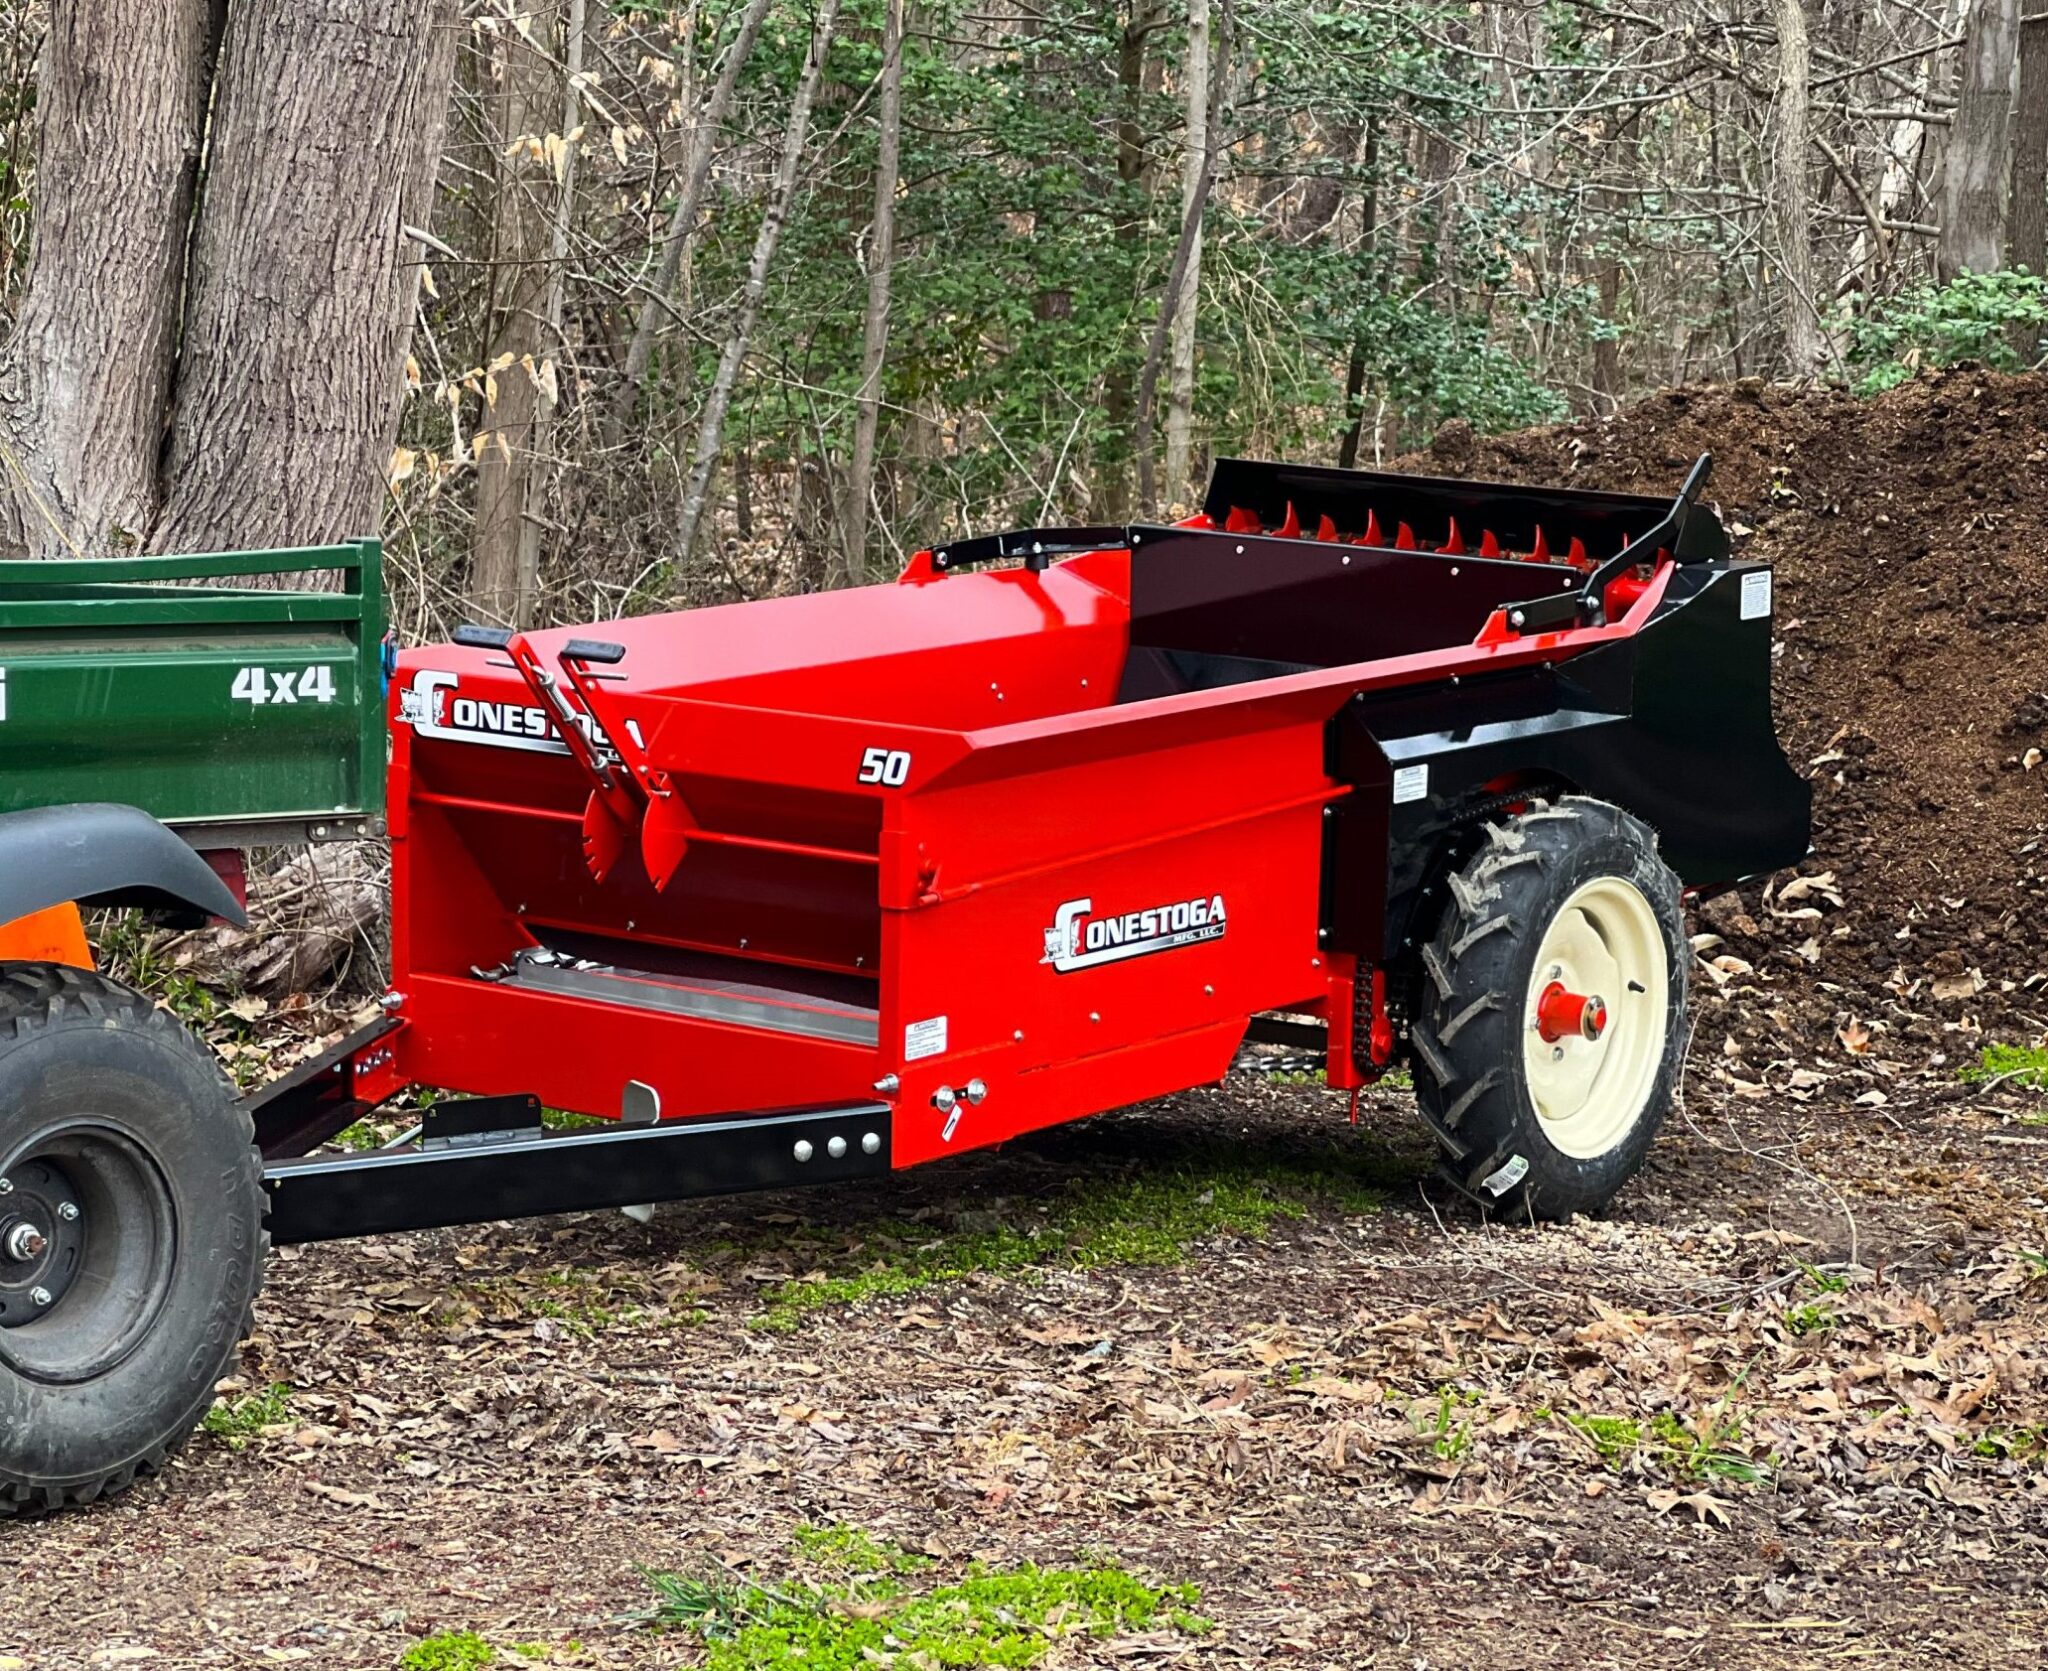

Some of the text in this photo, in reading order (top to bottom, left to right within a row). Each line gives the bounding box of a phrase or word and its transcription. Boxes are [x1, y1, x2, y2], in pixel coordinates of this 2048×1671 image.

[231, 666, 336, 704] 4x4
[413, 669, 645, 750] CONES
[858, 747, 911, 786] 50
[1054, 894, 1227, 971] CONESTOGA
[1173, 932, 1197, 943] MFG.
[186, 1213, 245, 1381] DURO
